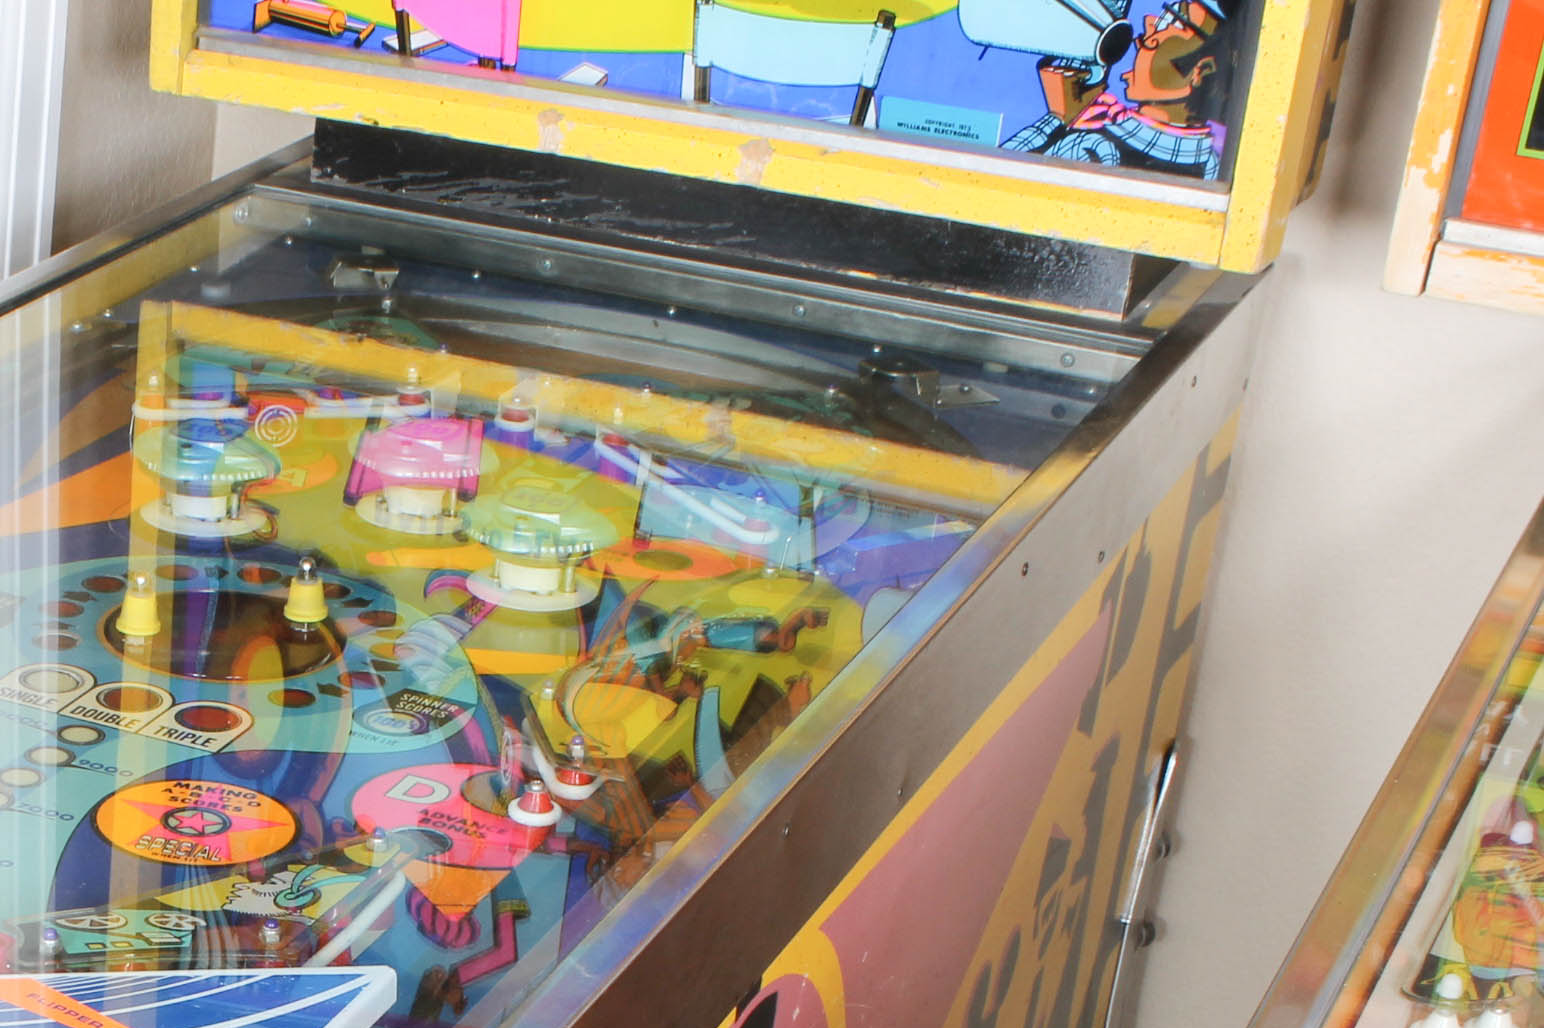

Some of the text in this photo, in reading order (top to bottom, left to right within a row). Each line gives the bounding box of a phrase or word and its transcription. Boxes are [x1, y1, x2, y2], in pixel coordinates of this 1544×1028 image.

[897, 122, 980, 140] WILLIAMS ELECTRONICS
[396, 701, 448, 718] SCORES
[400, 693, 460, 712] SPINNER
[70, 706, 140, 730] DOUBLE
[154, 725, 218, 748] TRIPLE
[78, 758, 134, 777] 9000
[172, 782, 258, 800] MAKING
[385, 774, 452, 804] D
[168, 796, 244, 812] SCORES
[418, 808, 509, 834] ADVANCE
[418, 817, 488, 839] BONUS
[135, 834, 222, 862] SPECIAL
